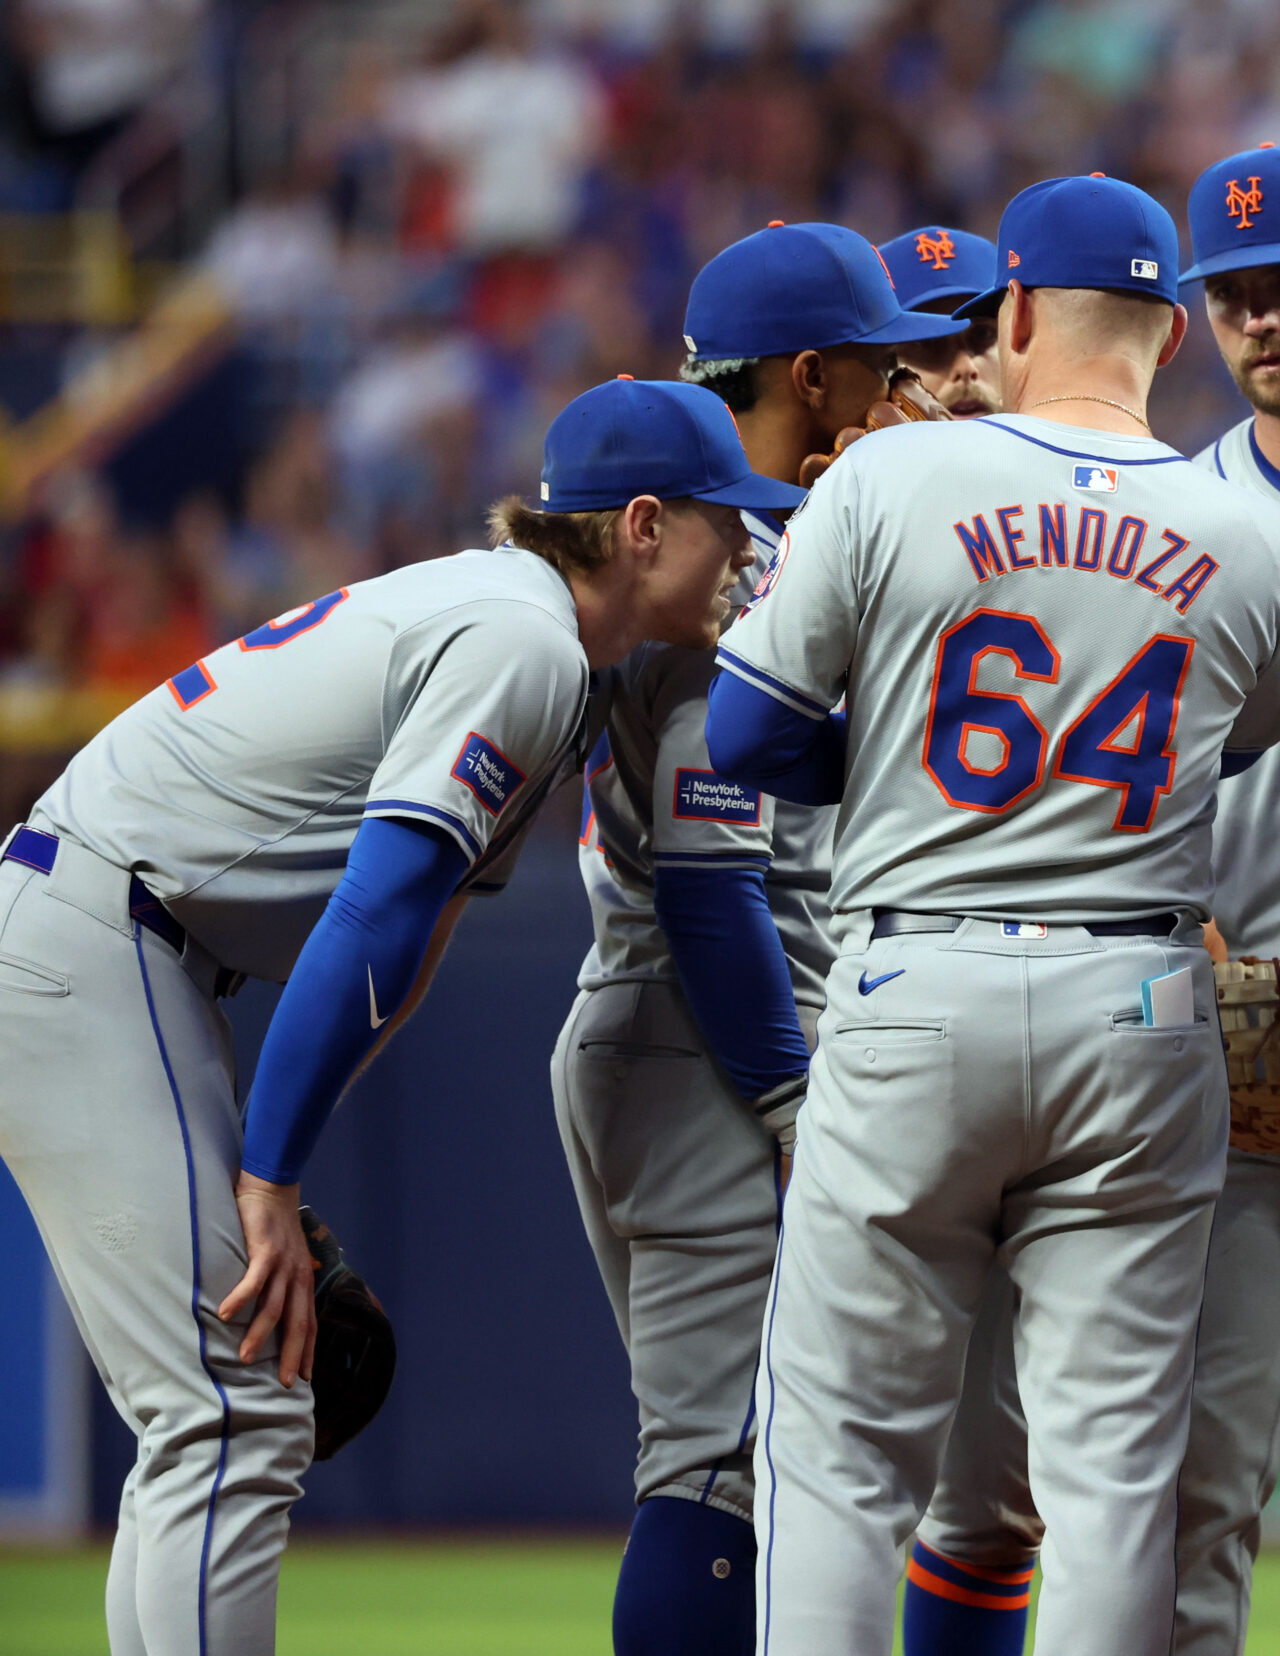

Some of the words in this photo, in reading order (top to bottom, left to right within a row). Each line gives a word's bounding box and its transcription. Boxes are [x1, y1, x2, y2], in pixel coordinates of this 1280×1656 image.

[953, 503, 1220, 615] MENDOZA
[921, 606, 1196, 833] 64
[692, 794, 755, 812] Presbyterian
[693, 781, 744, 797] NewYork-
